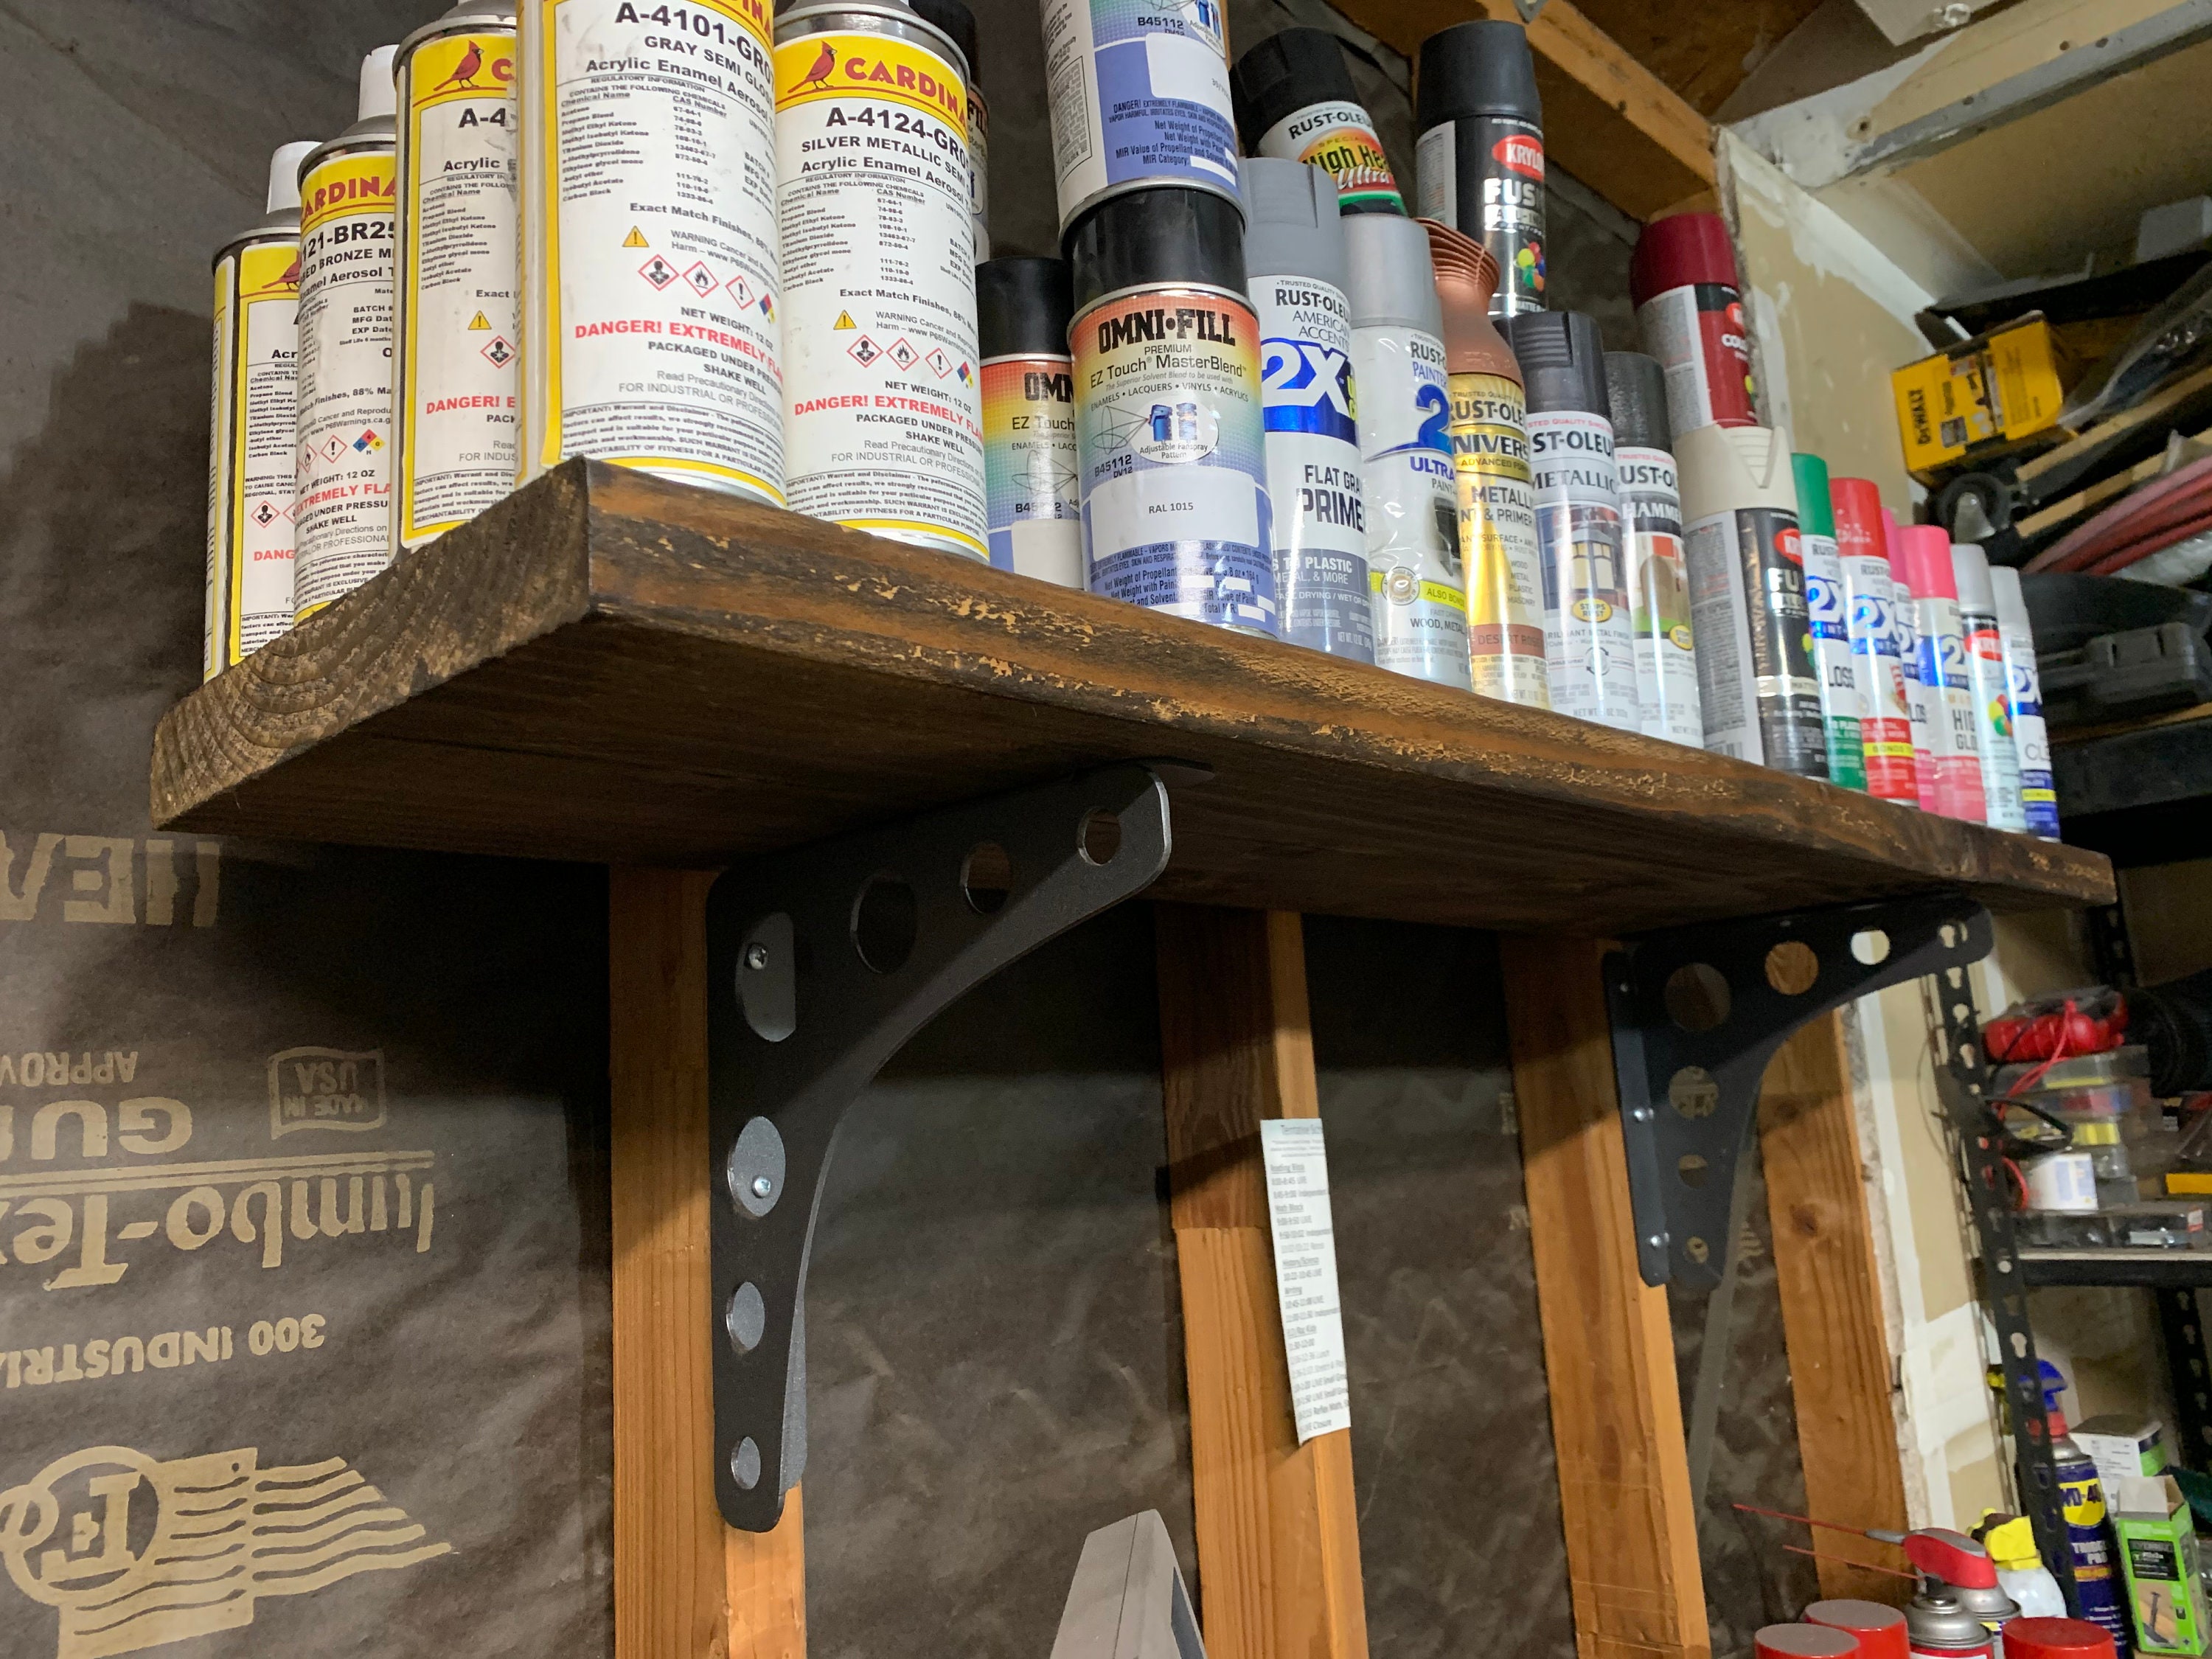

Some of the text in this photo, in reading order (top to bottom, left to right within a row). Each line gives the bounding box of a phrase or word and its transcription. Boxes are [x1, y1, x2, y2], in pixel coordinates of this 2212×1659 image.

[1137, 16, 1183, 29] B45112
[644, 36, 741, 76] GRAY SEMI
[585, 58, 722, 88] Acrylic Enamel
[1113, 100, 1141, 114] DANGER!
[1155, 121, 1166, 130] Net
[1168, 121, 1190, 132] Weight
[826, 108, 969, 169] A-4124-GR0
[802, 136, 965, 183] SILVER METALLIC SEMI
[1116, 144, 1193, 159] MIR Value Propellant
[1143, 154, 1157, 164] MIR
[443, 157, 501, 173] Acrylic
[801, 157, 857, 173] Acrylic
[864, 157, 920, 177] Enamel
[805, 173, 905, 183] REGULATORY INFORMATION
[781, 187, 839, 206] Chemical Name
[788, 184, 820, 197] CONTAINS
[886, 184, 923, 197] CHEMICALS
[895, 191, 925, 205] Number
[630, 203, 709, 223] Exact Match
[671, 230, 717, 248] WARNING
[319, 248, 373, 270] BRONZE
[330, 267, 382, 284] Aerosol
[1312, 283, 1336, 295] QUALITY
[876, 289, 909, 301] Match
[913, 296, 951, 316] Finishes,
[681, 307, 705, 319] NET
[876, 311, 944, 330] WARNING Cancer
[876, 321, 899, 331] Harm
[575, 321, 766, 364] DANGER! EXTREMELY
[648, 341, 717, 360] PACKAGED
[1144, 344, 1192, 356] PREMIUM
[658, 371, 684, 382] Read
[704, 364, 766, 394] SHAKE WELL
[1091, 370, 1104, 389] EZ
[1142, 373, 1166, 383] Solvent
[1168, 371, 1187, 380] Blend
[1261, 338, 1351, 419] 2X
[352, 388, 374, 397] 88%
[647, 383, 717, 401] INDUSTRIAL
[886, 380, 973, 414] NET WEIGHT: 12 OZ
[1091, 382, 1249, 412] ENAMELS LACQUERS VINYLS ACRYLICS
[426, 396, 500, 414] DANGER!
[795, 395, 963, 425] DANGER! EXTREMELY
[856, 414, 953, 436] PACKAGED UNDER
[1012, 417, 1030, 431] EZ
[864, 440, 888, 450] Read
[891, 442, 947, 460] Precautionary
[905, 431, 964, 454] SHAKE WELL
[1139, 442, 1176, 454] Adjustable
[459, 453, 481, 462] FOR
[832, 453, 933, 466] FOR INDUSTRIAL OR
[1094, 453, 1133, 478] B45112
[1461, 459, 1512, 467] ADVANCED
[1113, 466, 1133, 479] DV12
[1304, 464, 1340, 484] FLAT
[1410, 456, 1455, 480] ULTRA
[314, 505, 343, 518] UNDER
[1149, 502, 1194, 514] RAL 1015
[305, 515, 357, 534] SHAKE WELL
[335, 526, 374, 537] Directions
[1483, 535, 1517, 543] SURFACE
[1305, 557, 1352, 573] PLASTIC
[1113, 567, 1178, 588] Weight Propellant
[1324, 572, 1349, 585] MORE
[1338, 593, 1352, 602] WET
[1426, 588, 1447, 601] ALSO
[1410, 618, 1443, 630] WOOD,
[297, 1062, 358, 1093] USA
[285, 1094, 305, 1118] IN
[249, 1314, 326, 1356] 300
